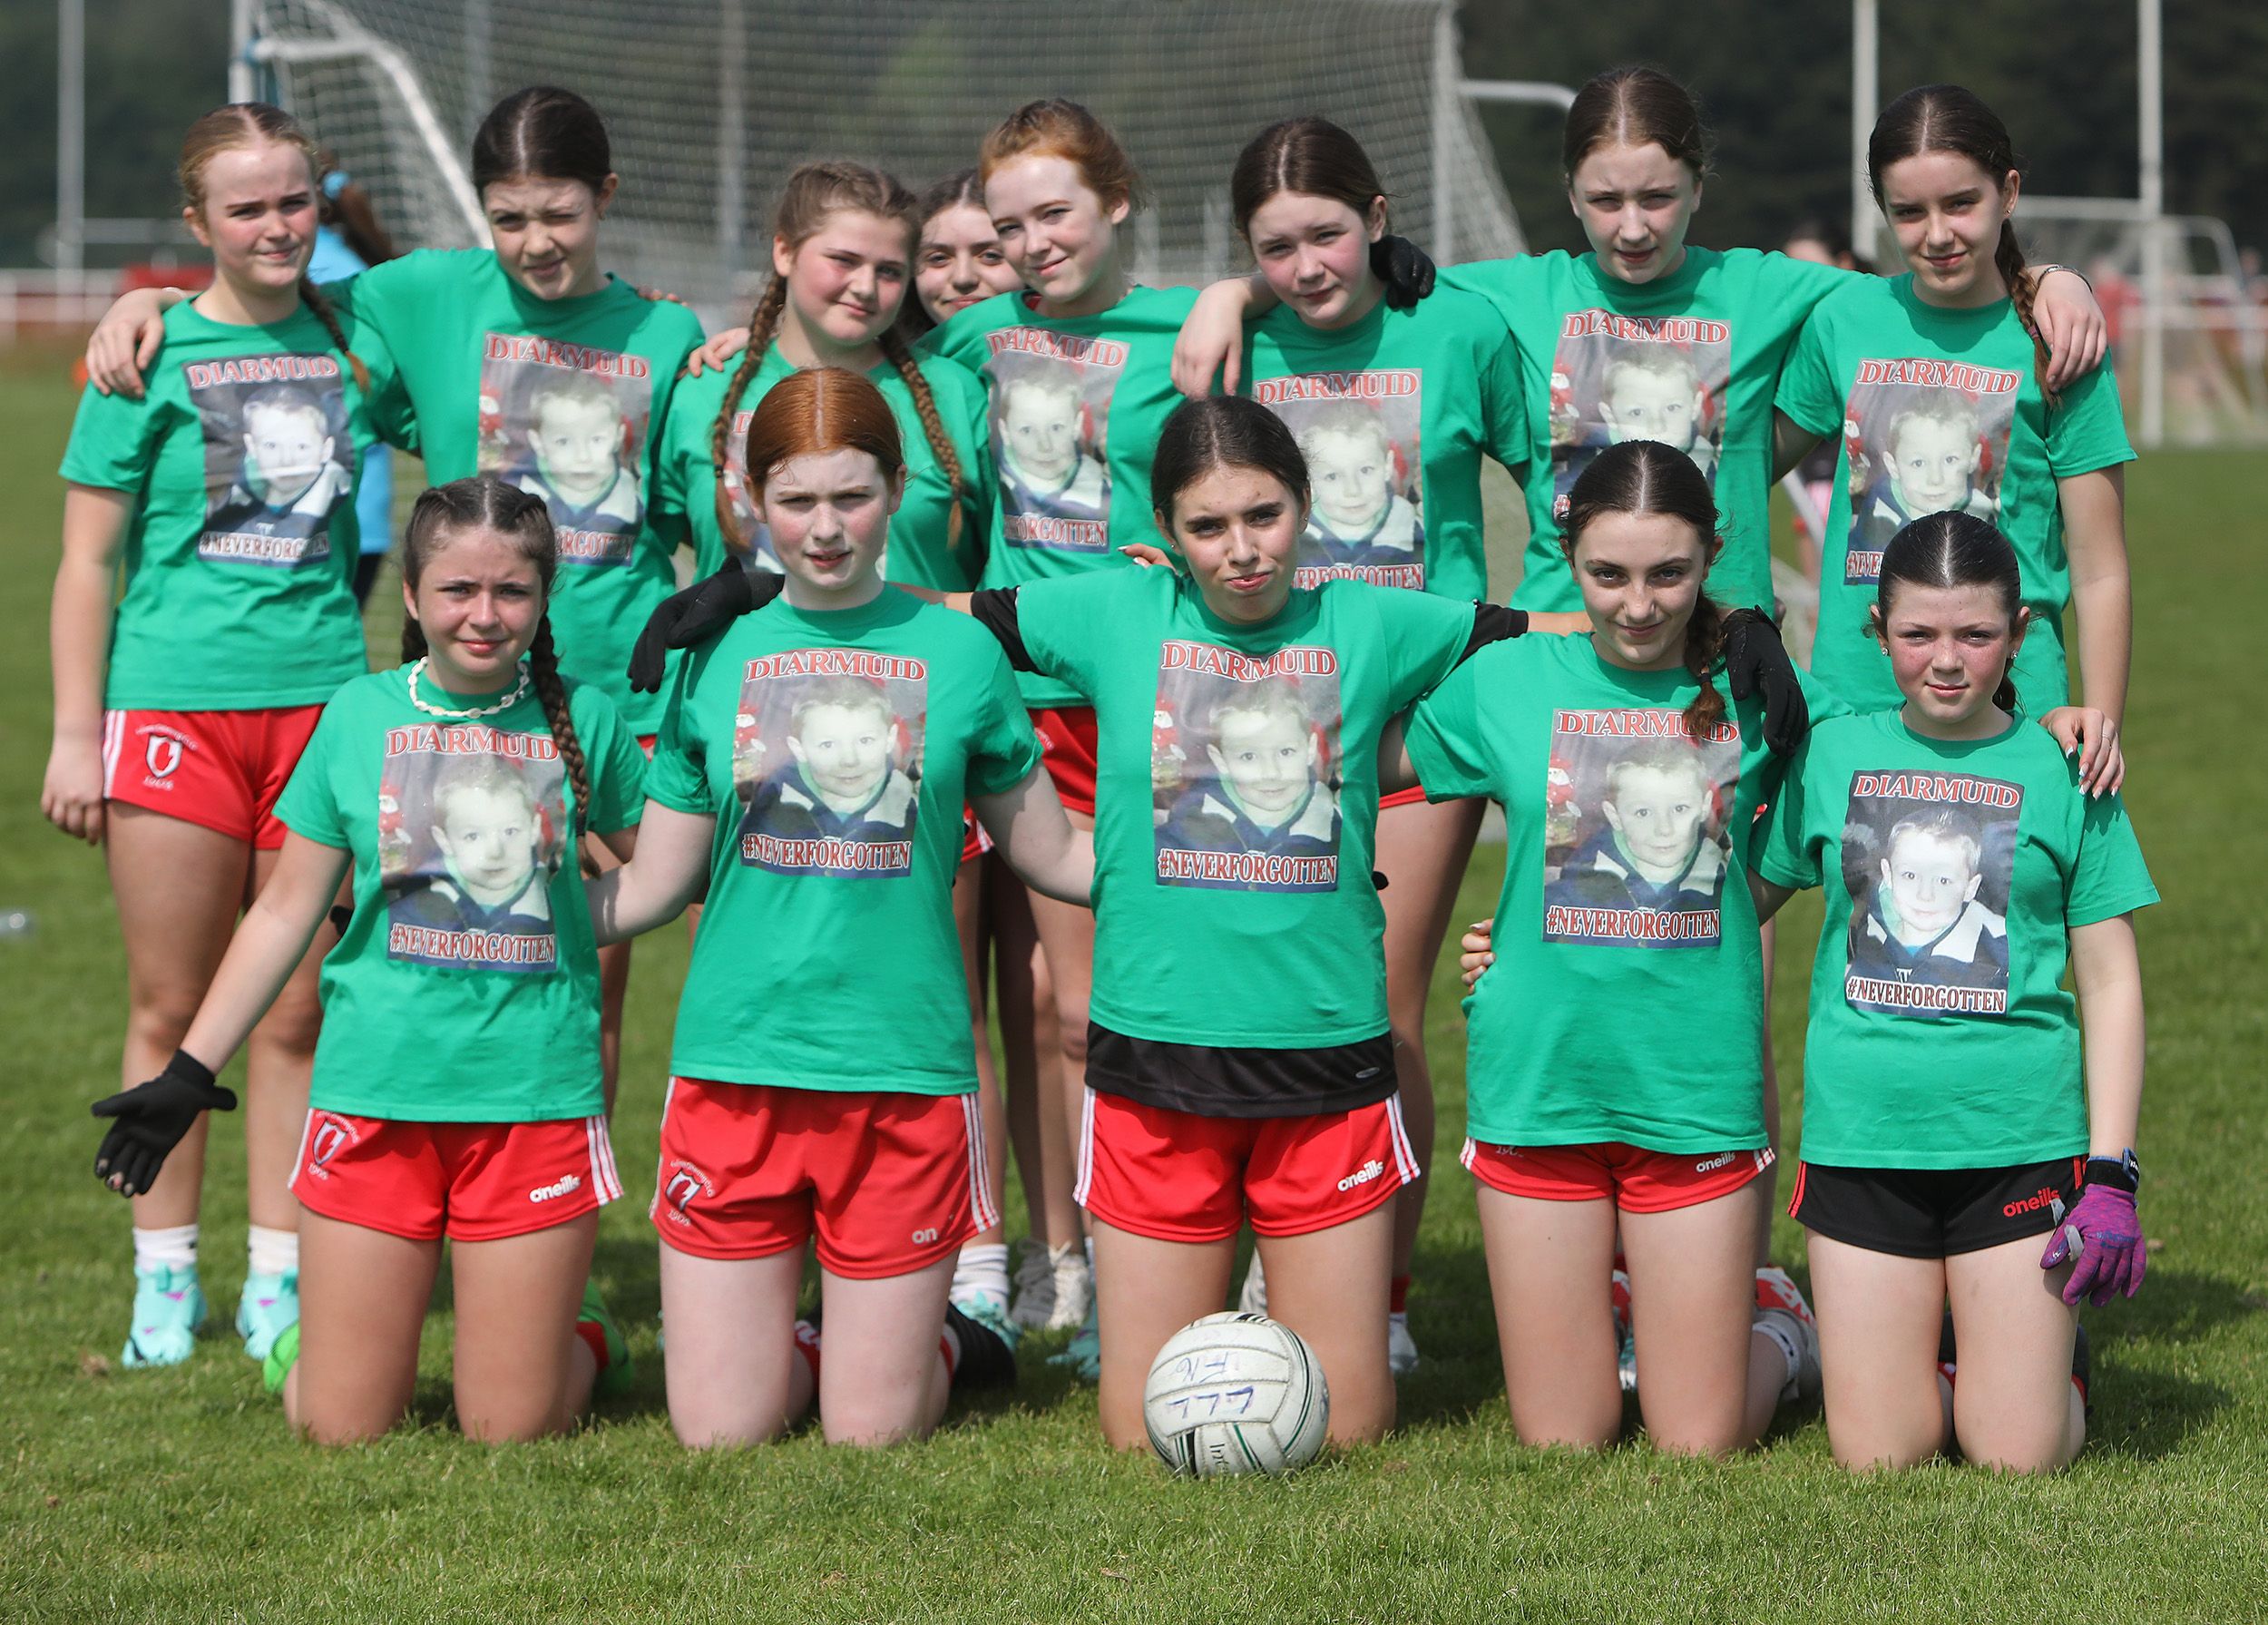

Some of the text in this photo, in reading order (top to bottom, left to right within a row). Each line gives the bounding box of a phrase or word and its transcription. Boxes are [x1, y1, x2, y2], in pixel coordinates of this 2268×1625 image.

[1562, 309, 1729, 345] DIARMUID
[187, 356, 338, 390] DIARMUID
[484, 333, 648, 378] DIARMUID
[1256, 372, 1419, 406] DIARMUID
[1857, 359, 2019, 395] DIARMUID
[745, 651, 926, 682] DIARMUID
[1160, 641, 1337, 682] DIARMUID
[386, 724, 559, 762] DIARMUID
[1853, 774, 2020, 809] DIARMUID
[742, 833, 912, 871] #NEVERFORGOTTEN
[1158, 848, 1338, 885] #NEVERFORGOTTEN
[1546, 905, 1720, 940] #NEVERFORGOTTEN
[389, 922, 555, 964] #NEVERFORGOTTEN
[1846, 975, 2007, 1013] #NEVERFORGOTTEN
